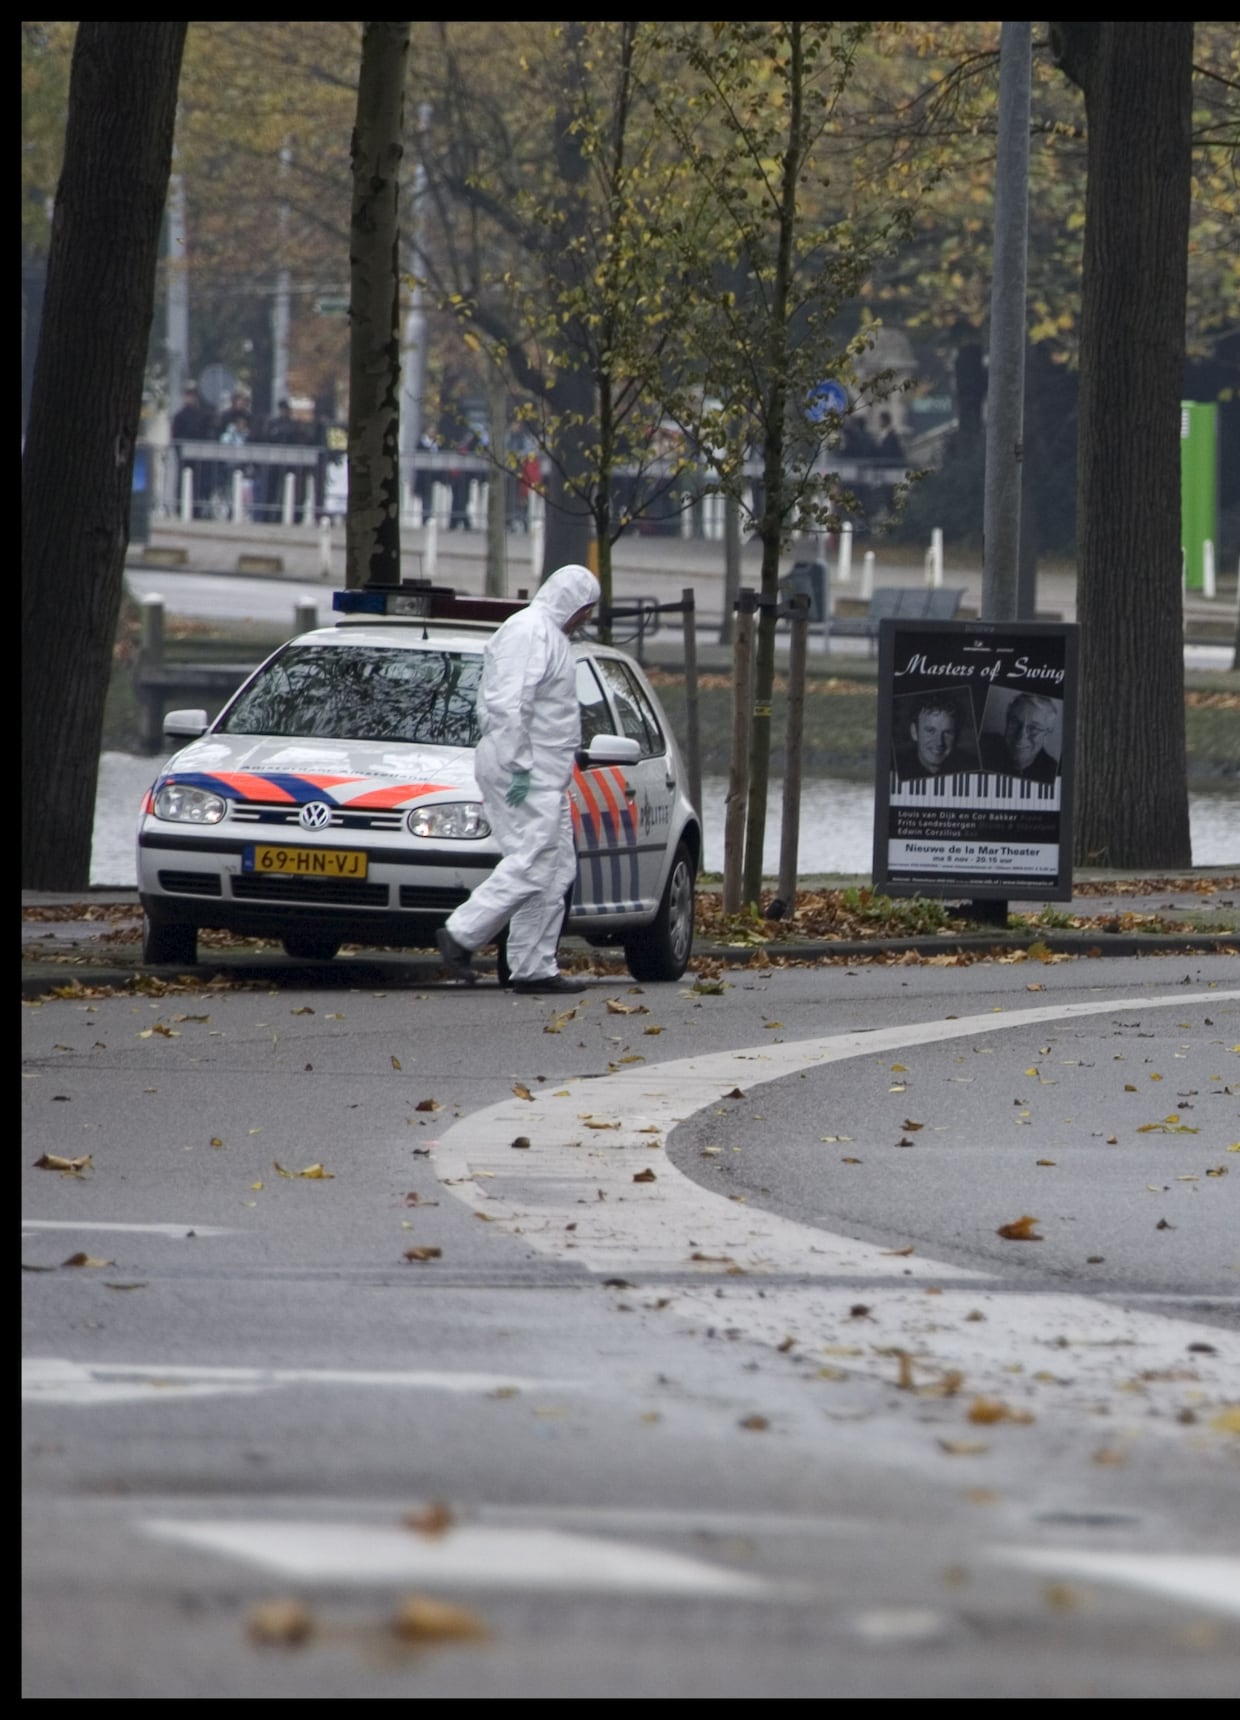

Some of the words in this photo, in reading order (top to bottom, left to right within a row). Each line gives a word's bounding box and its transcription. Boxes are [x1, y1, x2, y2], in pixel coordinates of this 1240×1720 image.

[894, 653, 975, 677] Masters
[980, 660, 1002, 682] of
[1006, 656, 1066, 684] Swing
[897, 810, 920, 818] Louis
[939, 811, 956, 820] Dijk
[972, 812, 986, 820] Cor
[989, 813, 1018, 821] Bakker
[897, 819, 916, 827] Frits
[897, 827, 923, 835] Edwin
[905, 843, 945, 854] Nieuwe
[948, 844, 962, 854] de
[965, 845, 975, 854] la
[978, 846, 999, 855] Mar
[1000, 846, 1040, 857] Theater
[260, 849, 360, 873] 69-HN-VJ
